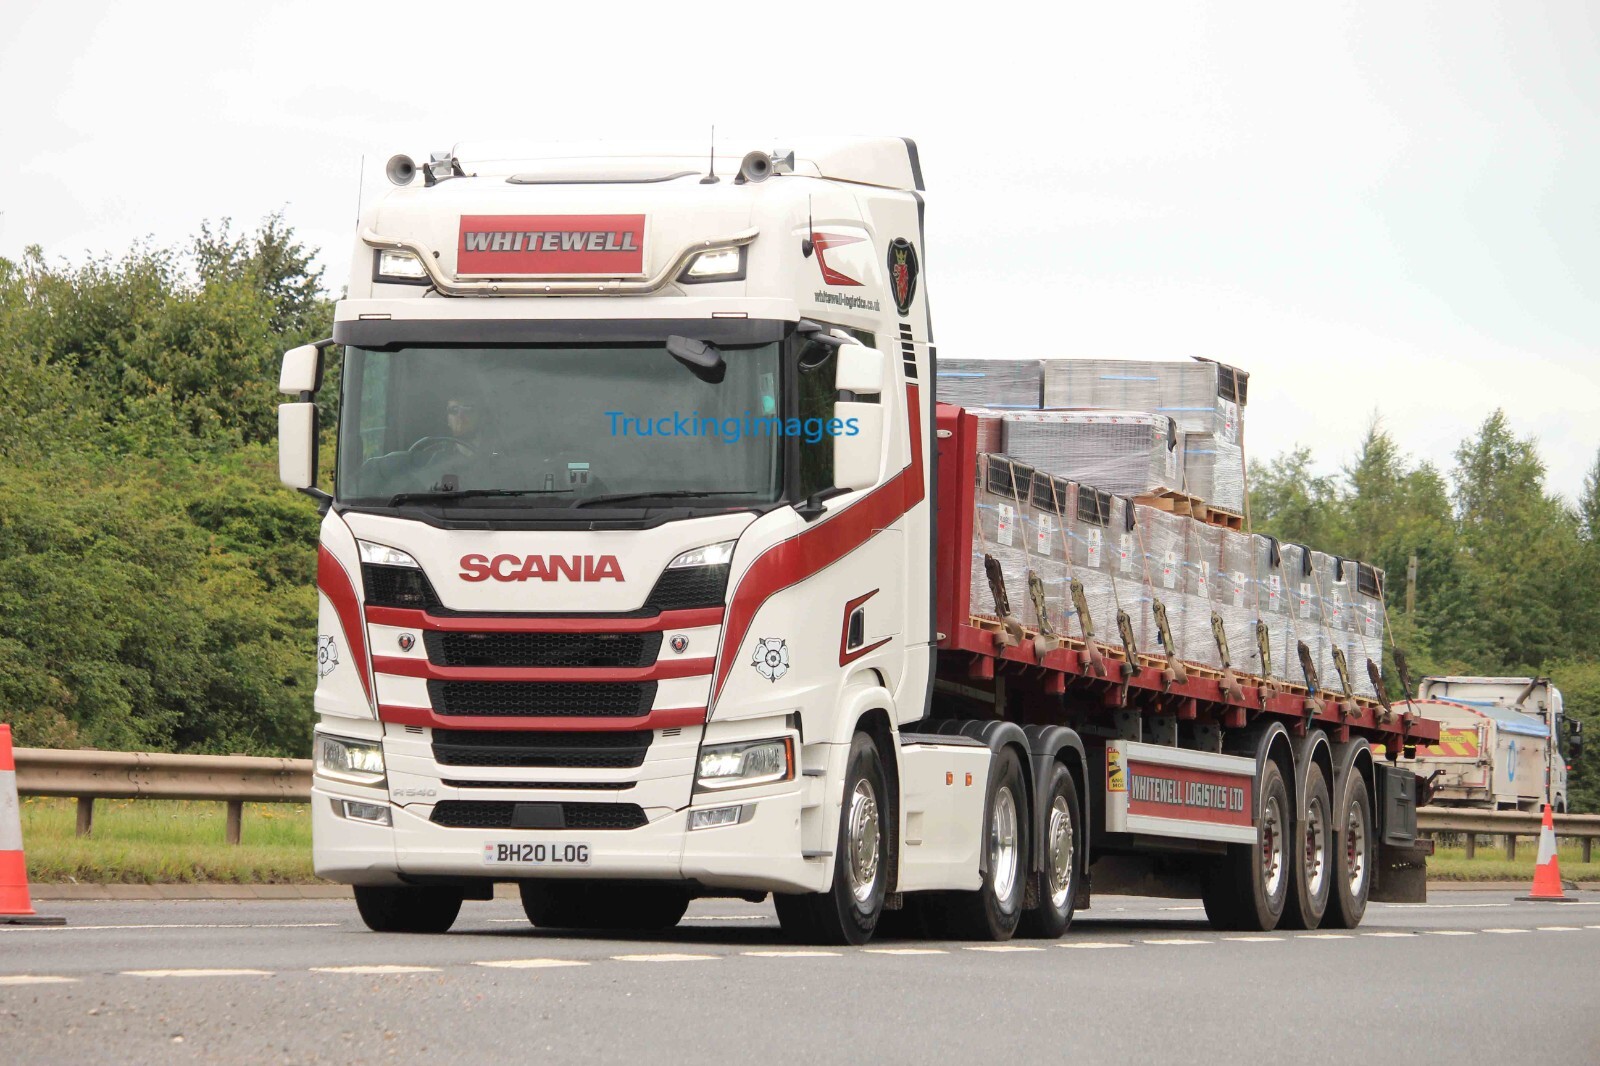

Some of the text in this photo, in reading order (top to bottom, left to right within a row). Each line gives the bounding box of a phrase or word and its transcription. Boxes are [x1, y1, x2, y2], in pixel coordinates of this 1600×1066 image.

[464, 231, 638, 252] WHITEWELL
[458, 553, 626, 582] SCANIA
[1131, 775, 1244, 811] WHITEWELL LOGISTICS LTD
[497, 844, 589, 862] BH20 LOG
